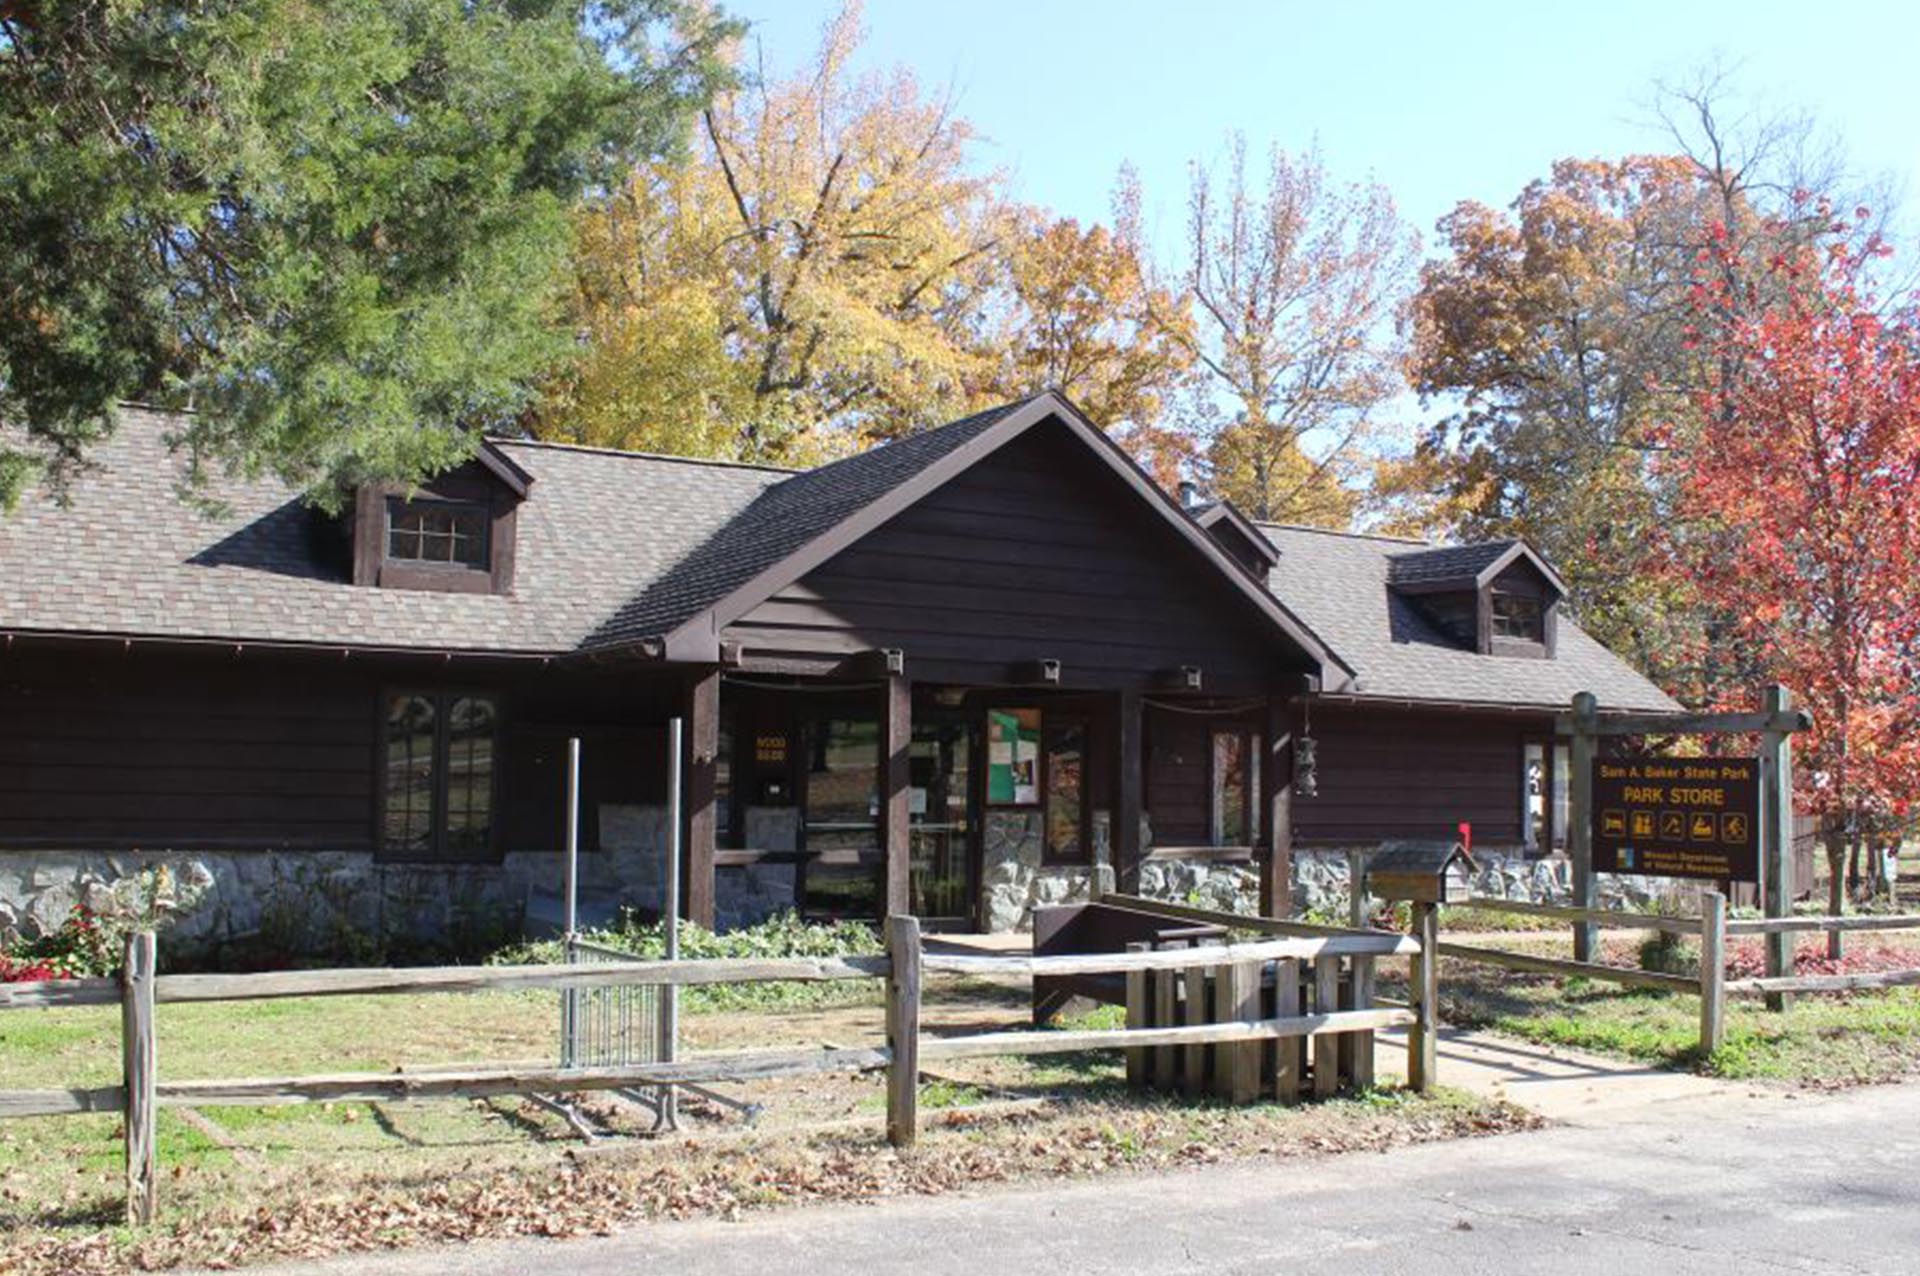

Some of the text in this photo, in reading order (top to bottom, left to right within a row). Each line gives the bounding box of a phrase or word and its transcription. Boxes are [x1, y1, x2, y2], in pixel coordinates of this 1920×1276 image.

[1601, 766, 1626, 778] Sam
[1630, 767, 1640, 778] A.
[1684, 767, 1717, 779] State
[1722, 767, 1749, 779] Park
[1624, 787, 1725, 804] PARK STORE
